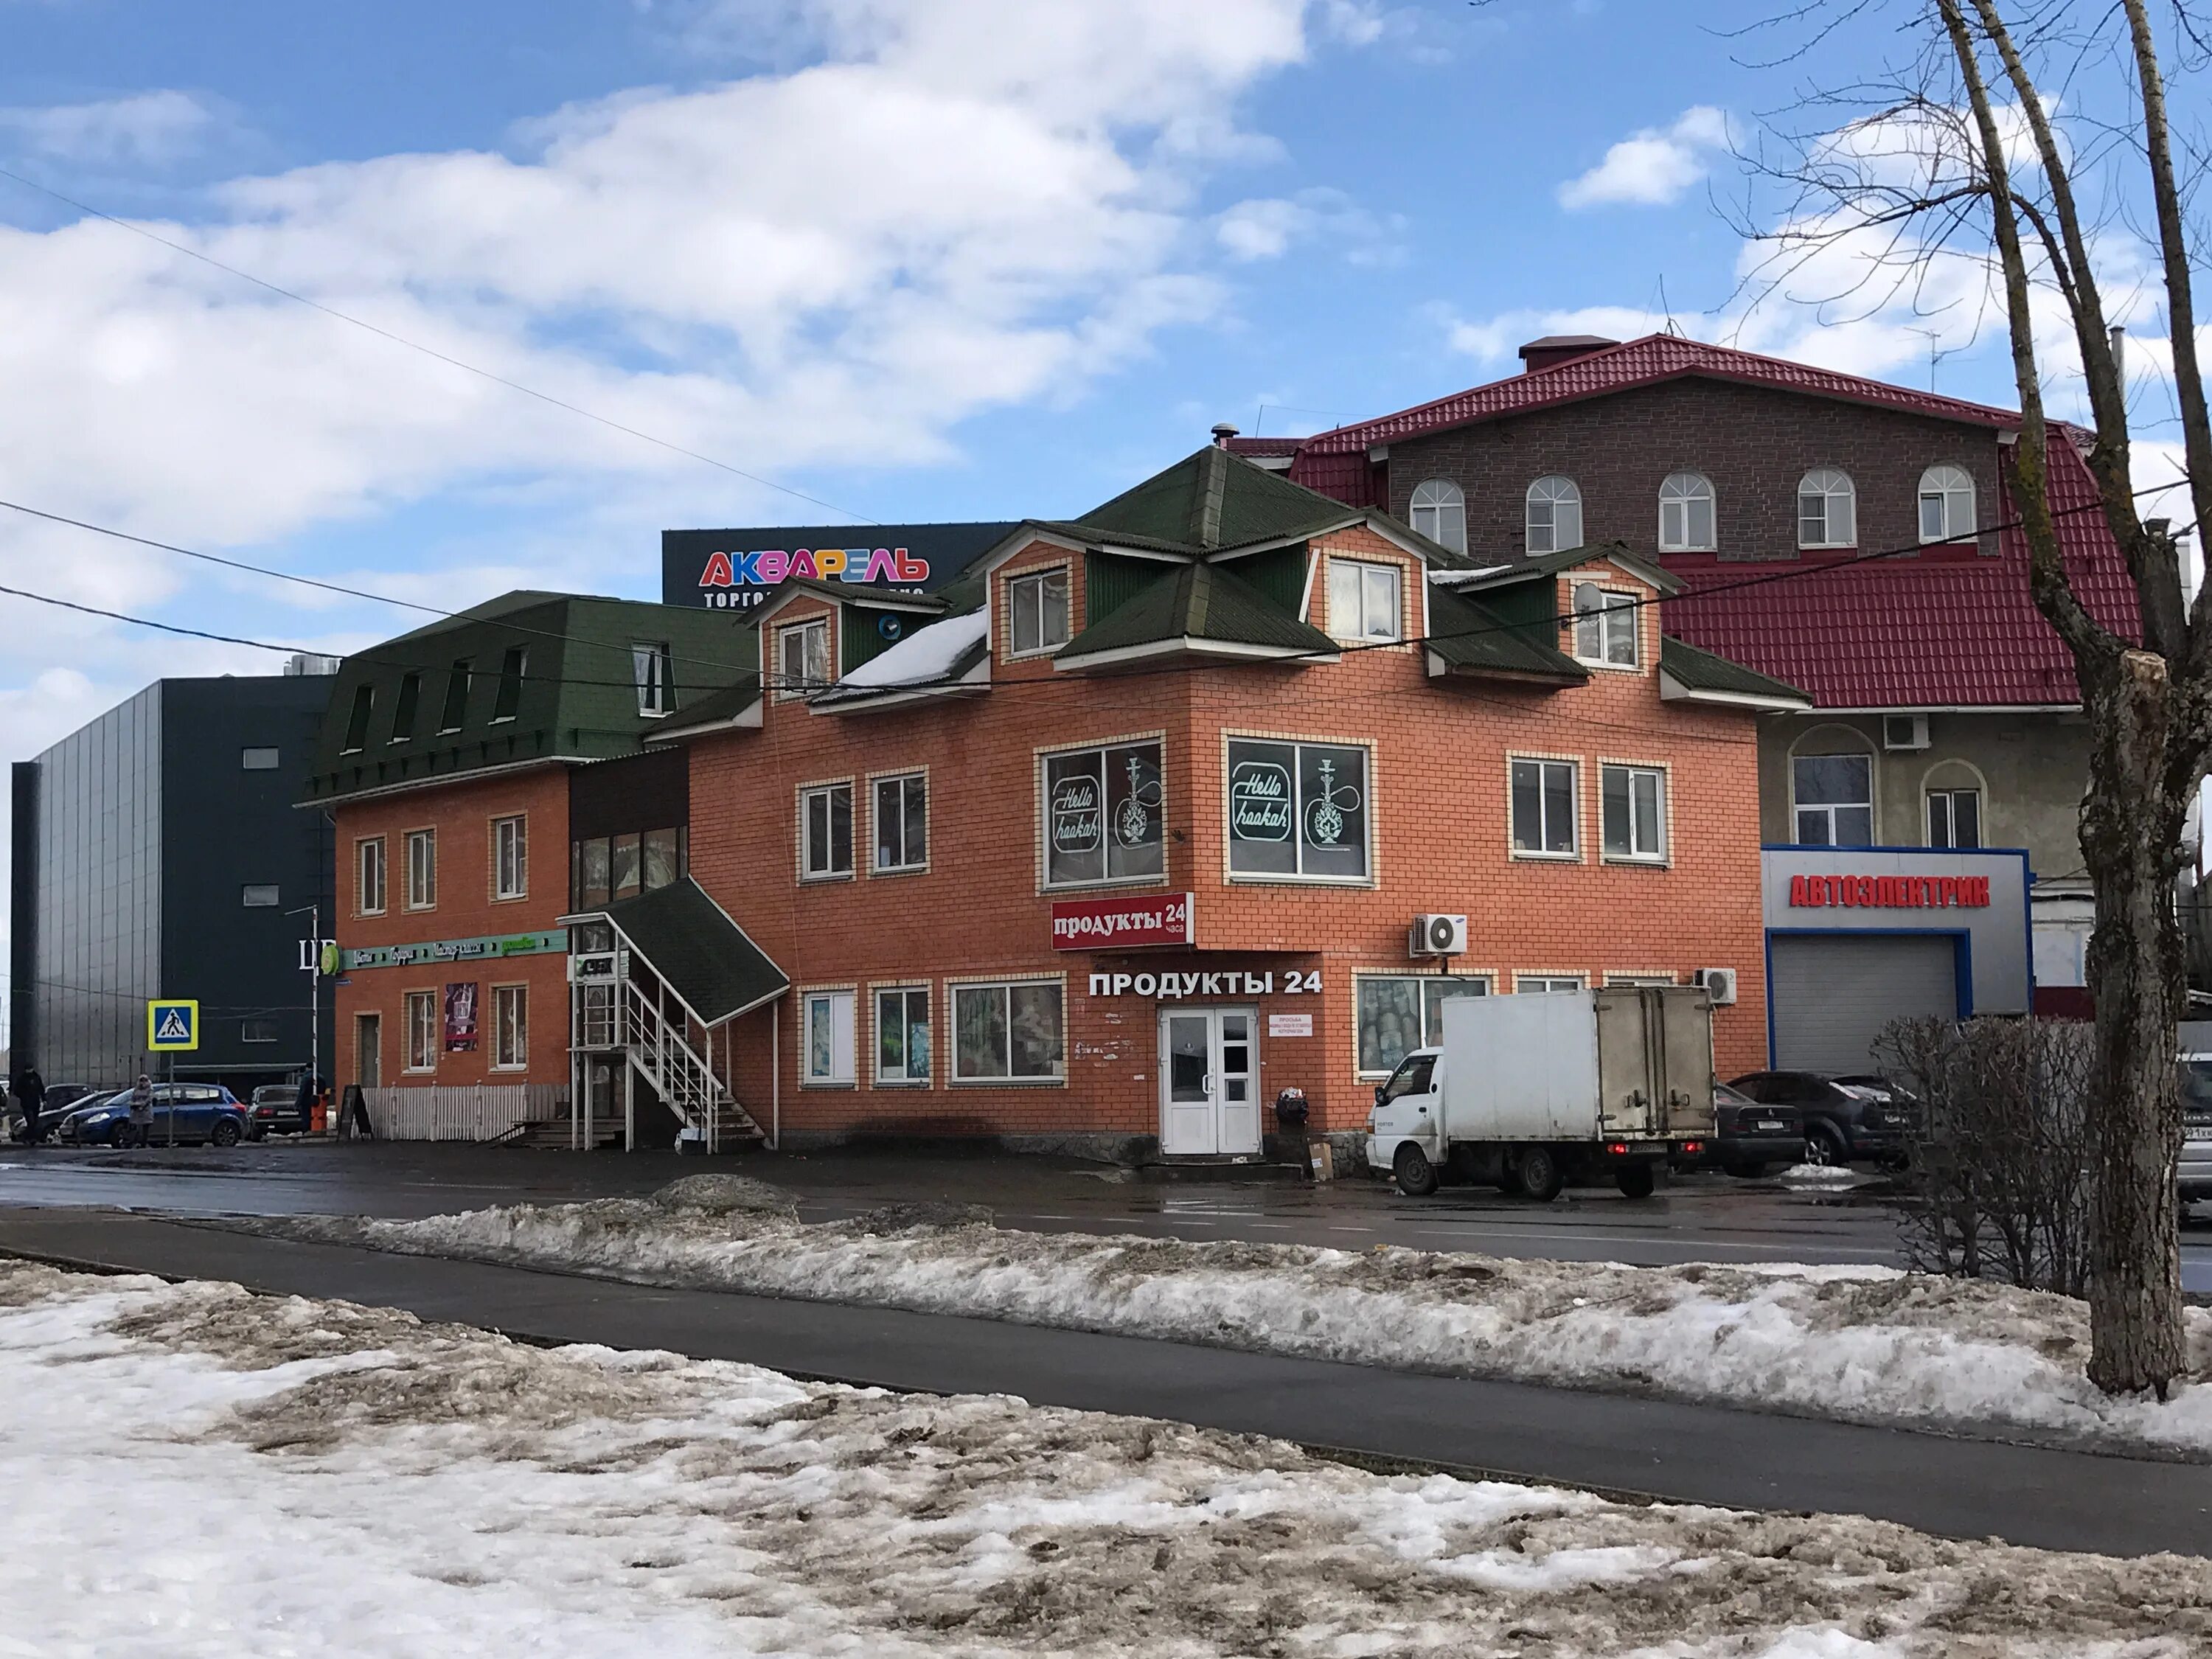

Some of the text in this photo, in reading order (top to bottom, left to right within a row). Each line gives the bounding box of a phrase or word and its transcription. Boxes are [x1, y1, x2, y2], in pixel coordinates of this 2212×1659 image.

[698, 548, 930, 588] АКВАРЕЛЬ
[704, 591, 772, 608] ТОРГО
[1062, 786, 1093, 809] Hello
[1245, 773, 1281, 796] Hello
[1056, 813, 1098, 839] hookah
[1236, 801, 1288, 827] hookah
[1790, 875, 1990, 908] АВТОЭЛЕКТРИК
[1054, 903, 1186, 939] продукты 24
[1166, 924, 1184, 933] часа
[1089, 970, 1323, 999] ПРОДУКТЫ 24
